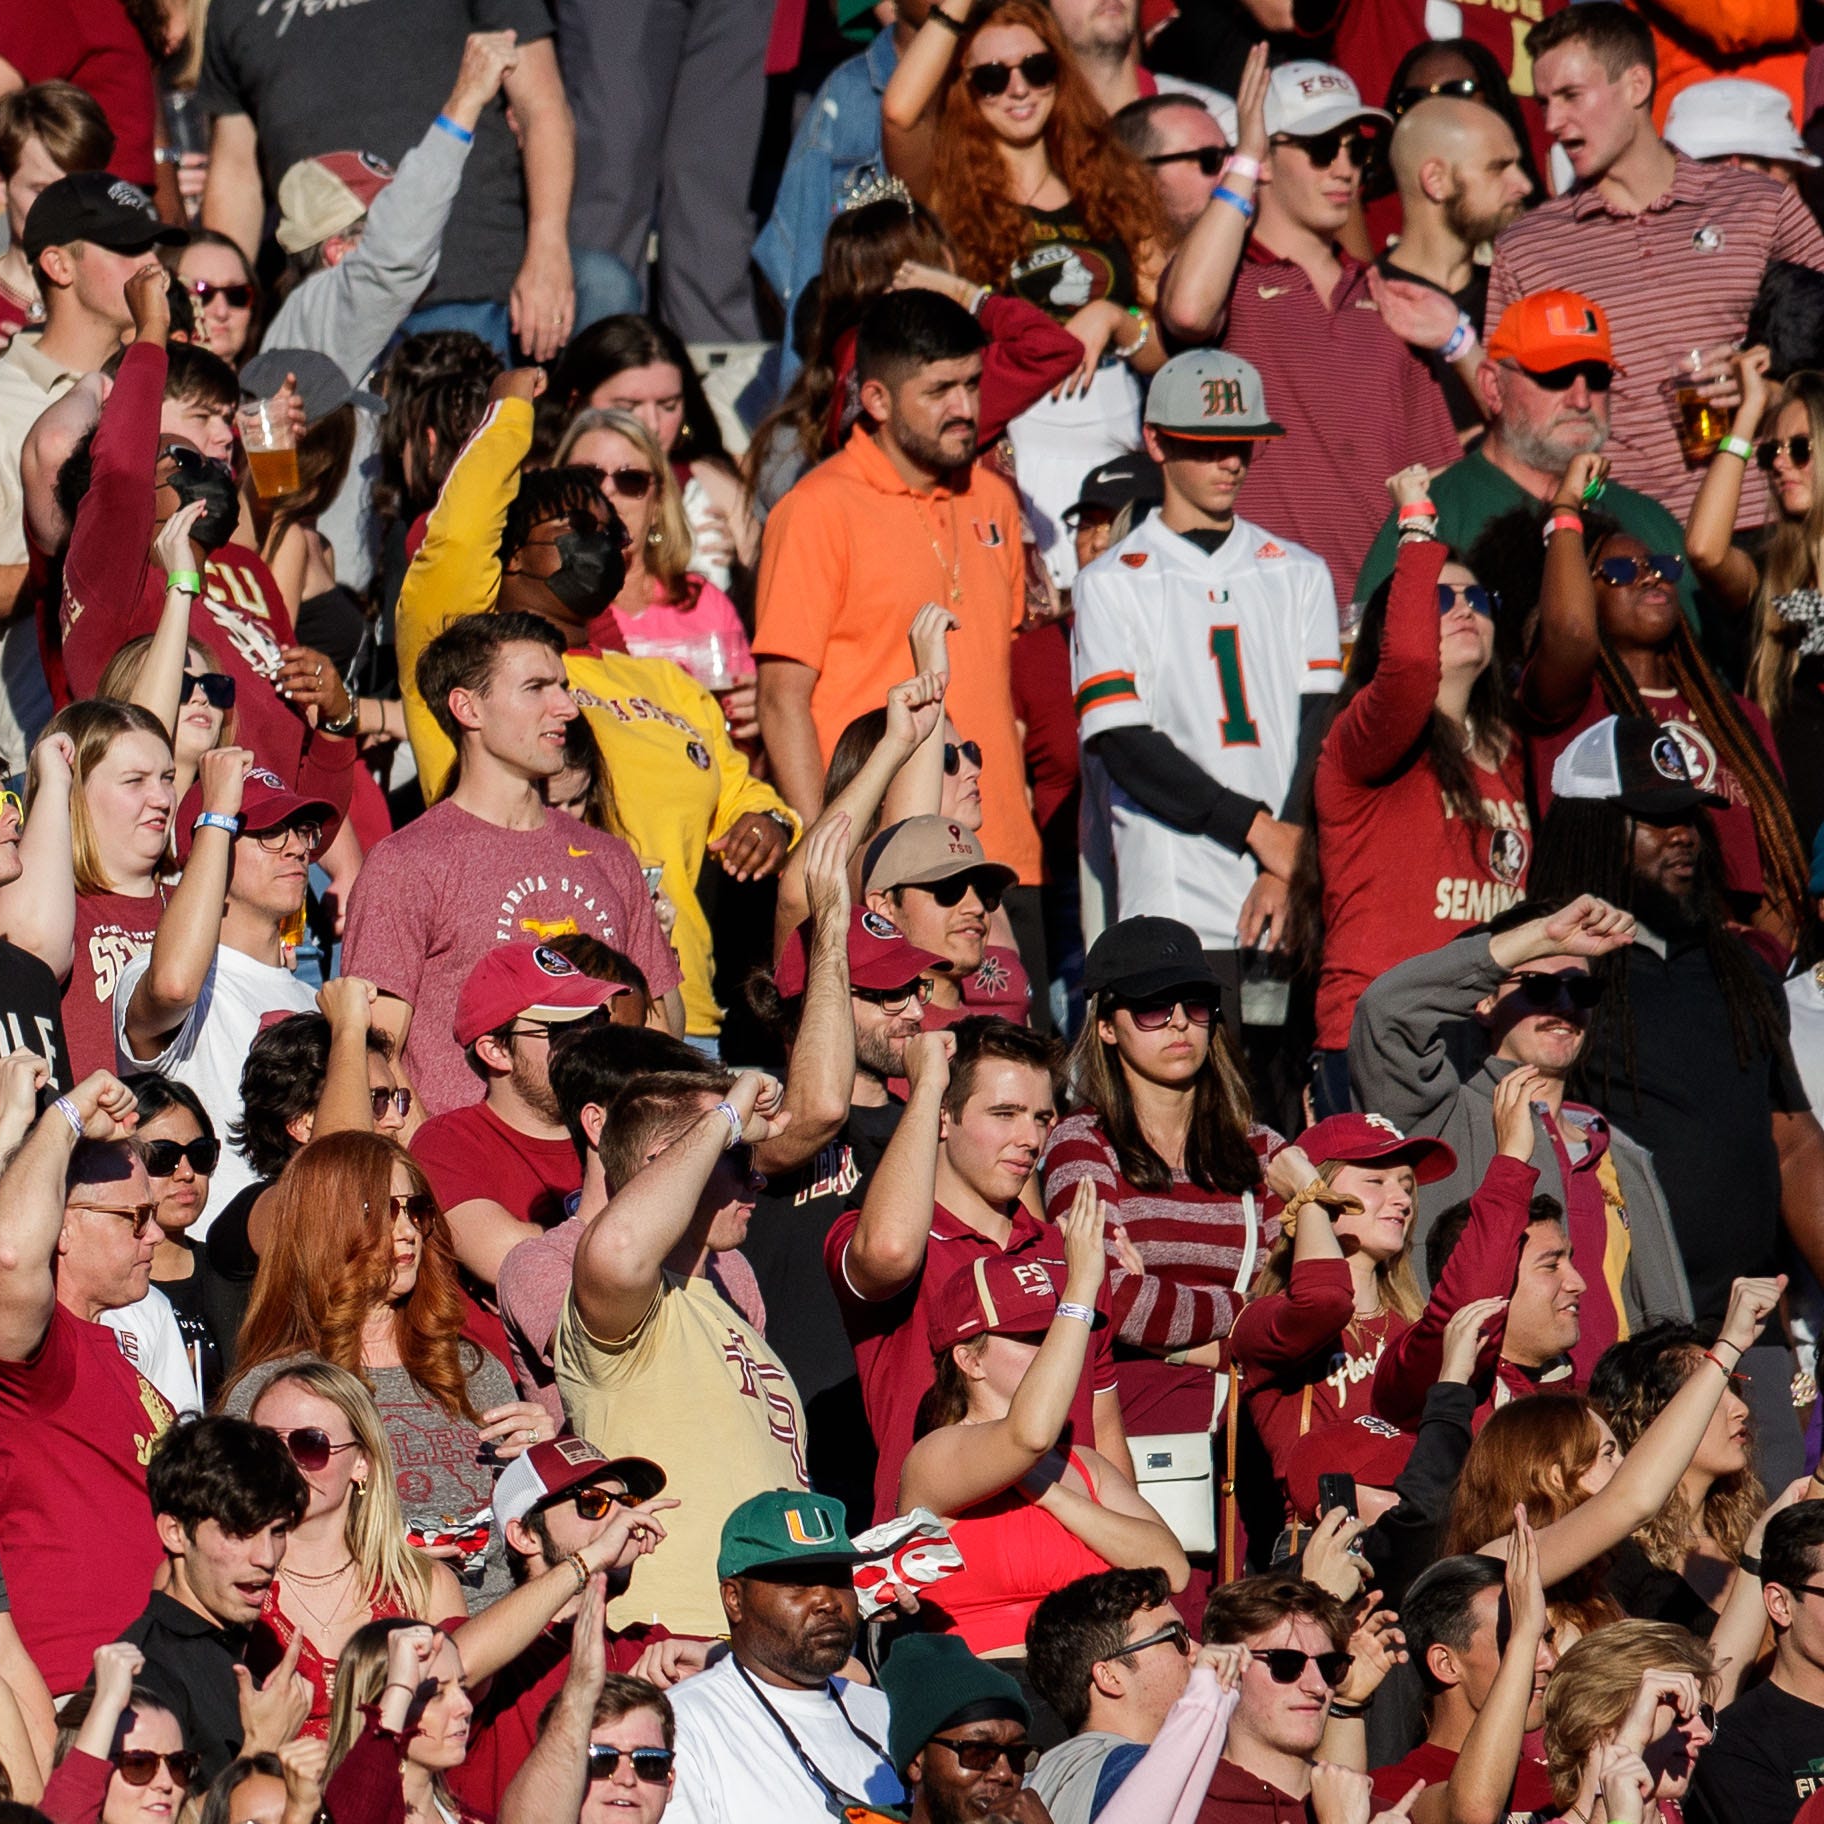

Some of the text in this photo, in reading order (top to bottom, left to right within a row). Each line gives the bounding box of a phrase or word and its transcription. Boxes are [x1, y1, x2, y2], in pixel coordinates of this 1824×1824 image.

[1546, 305, 1598, 336] U
[1200, 379, 1248, 418] M
[973, 521, 1005, 548] U
[1208, 589, 1230, 604] U
[1208, 626, 1260, 748] 1
[948, 842, 974, 857] FSU
[496, 876, 614, 942] FLORIDA STATE
[785, 1507, 837, 1545] U
